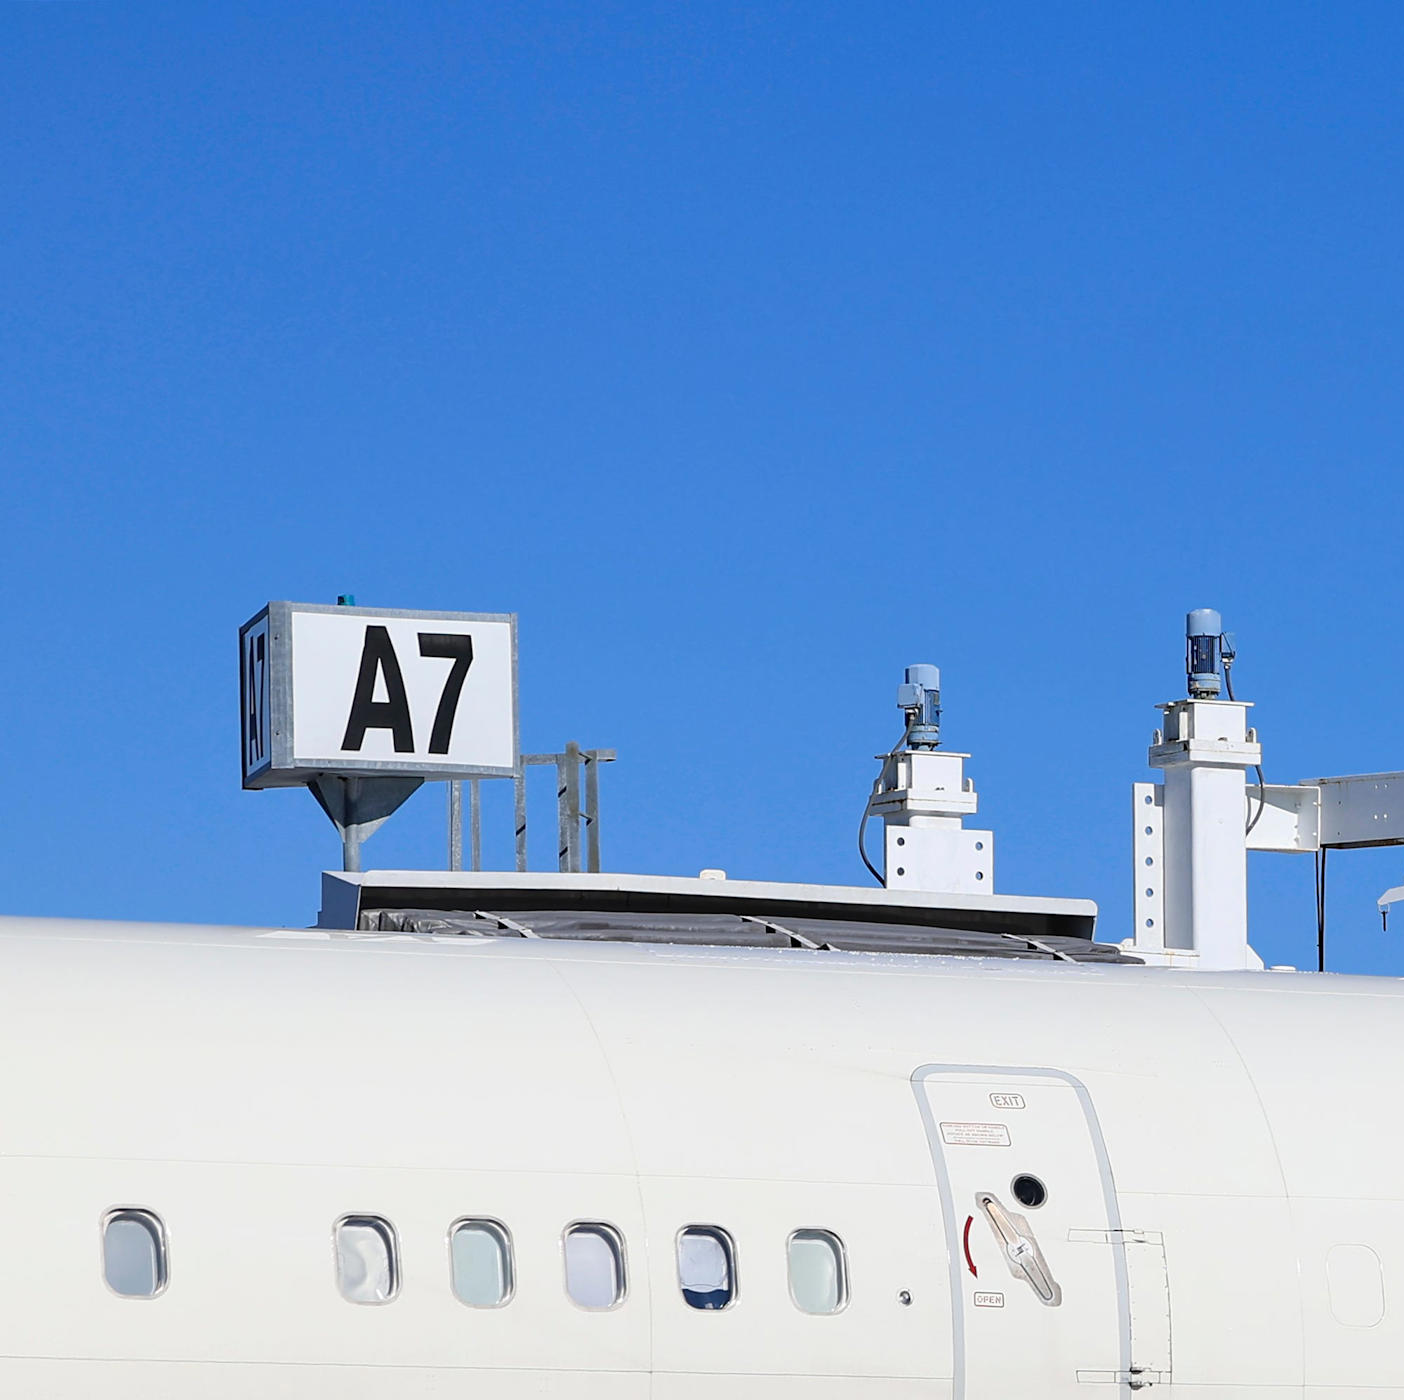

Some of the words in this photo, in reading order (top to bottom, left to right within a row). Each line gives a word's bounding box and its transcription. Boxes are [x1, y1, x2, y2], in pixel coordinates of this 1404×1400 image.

[340, 624, 474, 755] A7
[993, 1095, 1020, 1106] EXIT
[976, 1295, 1002, 1304] OPEN
